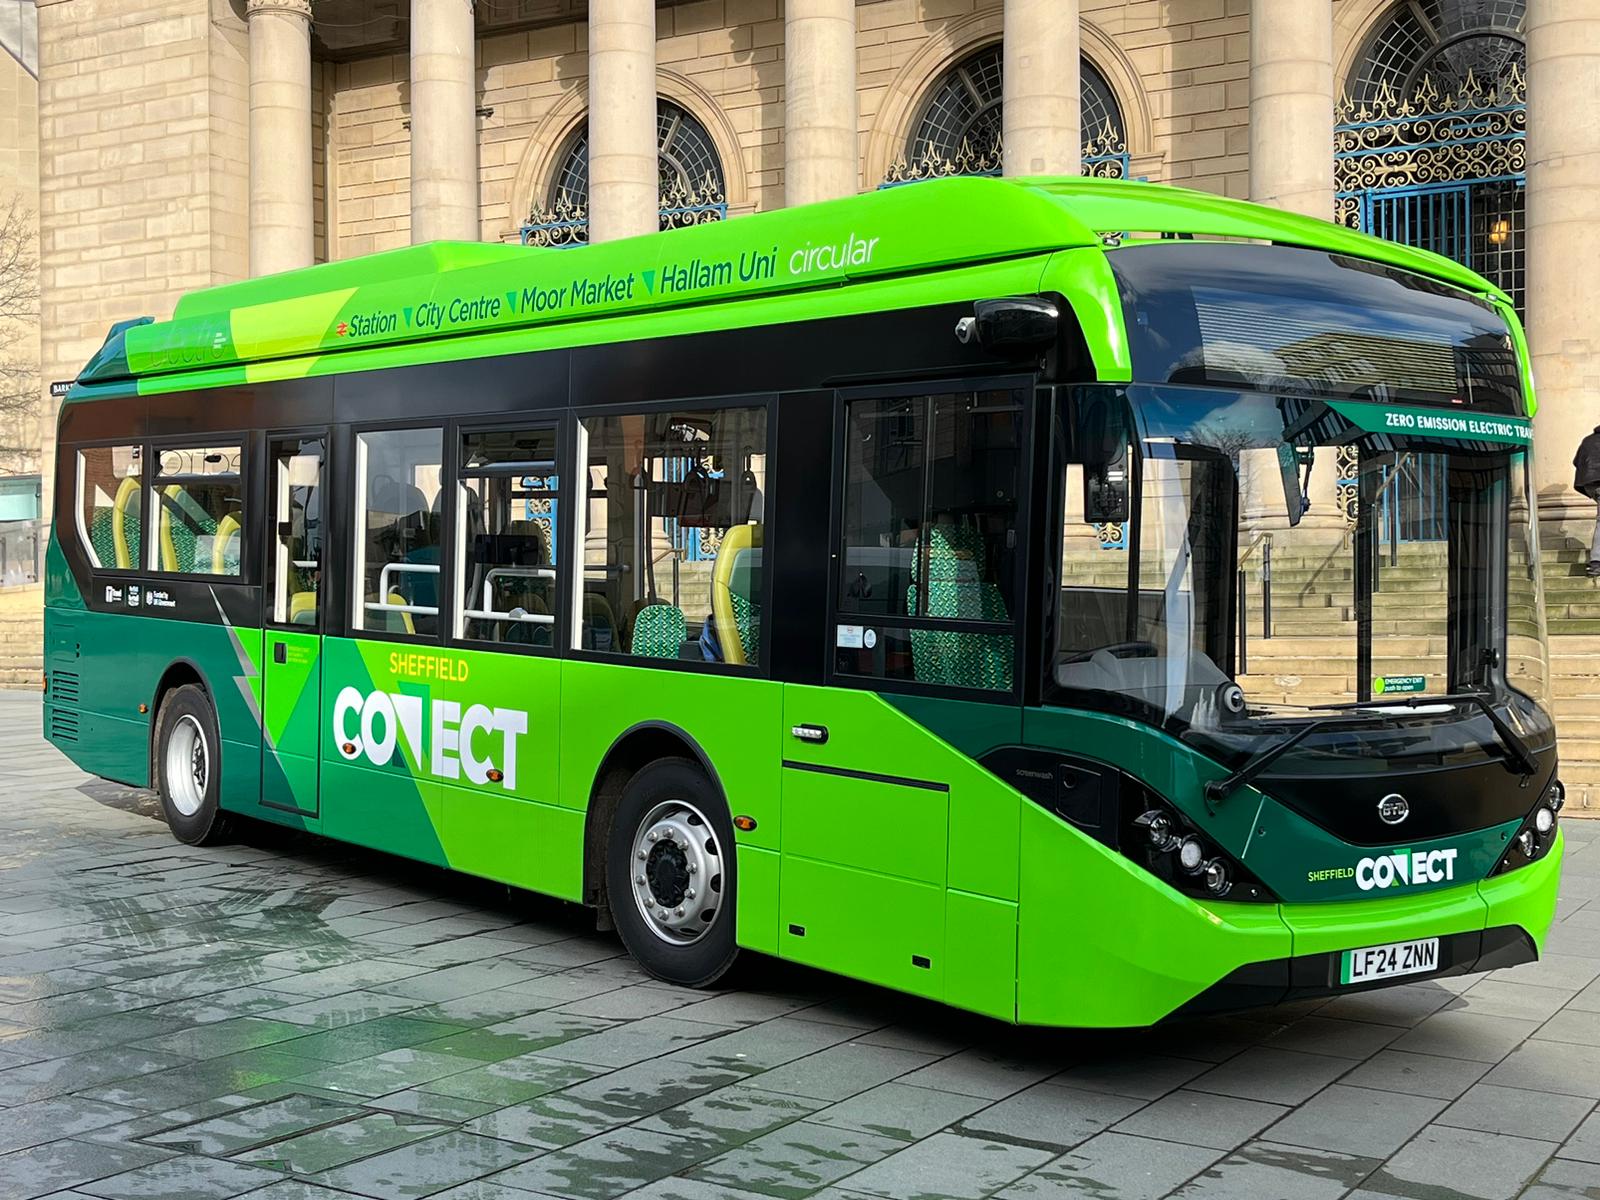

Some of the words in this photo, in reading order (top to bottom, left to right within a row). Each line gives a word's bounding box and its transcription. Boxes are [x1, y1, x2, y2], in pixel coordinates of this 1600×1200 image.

[349, 311, 397, 337] Station
[415, 302, 444, 330] City
[449, 295, 501, 324] Centre
[521, 287, 567, 314] Moor
[571, 271, 635, 307] Market
[660, 259, 732, 294] Hallam
[739, 246, 777, 282] Uni
[789, 232, 880, 275] circular
[1384, 412, 1415, 428] ZERO
[1417, 415, 1467, 432] EMISSION
[1469, 420, 1514, 436] ELECTRIC
[389, 652, 469, 682] SHEFFIELD
[1385, 677, 1412, 685] EMERGENCY
[1383, 802, 1405, 816] BYD
[1307, 867, 1354, 882] SHEFFIELD
[1353, 947, 1398, 977] LF24
[1402, 942, 1435, 969] ZNN
